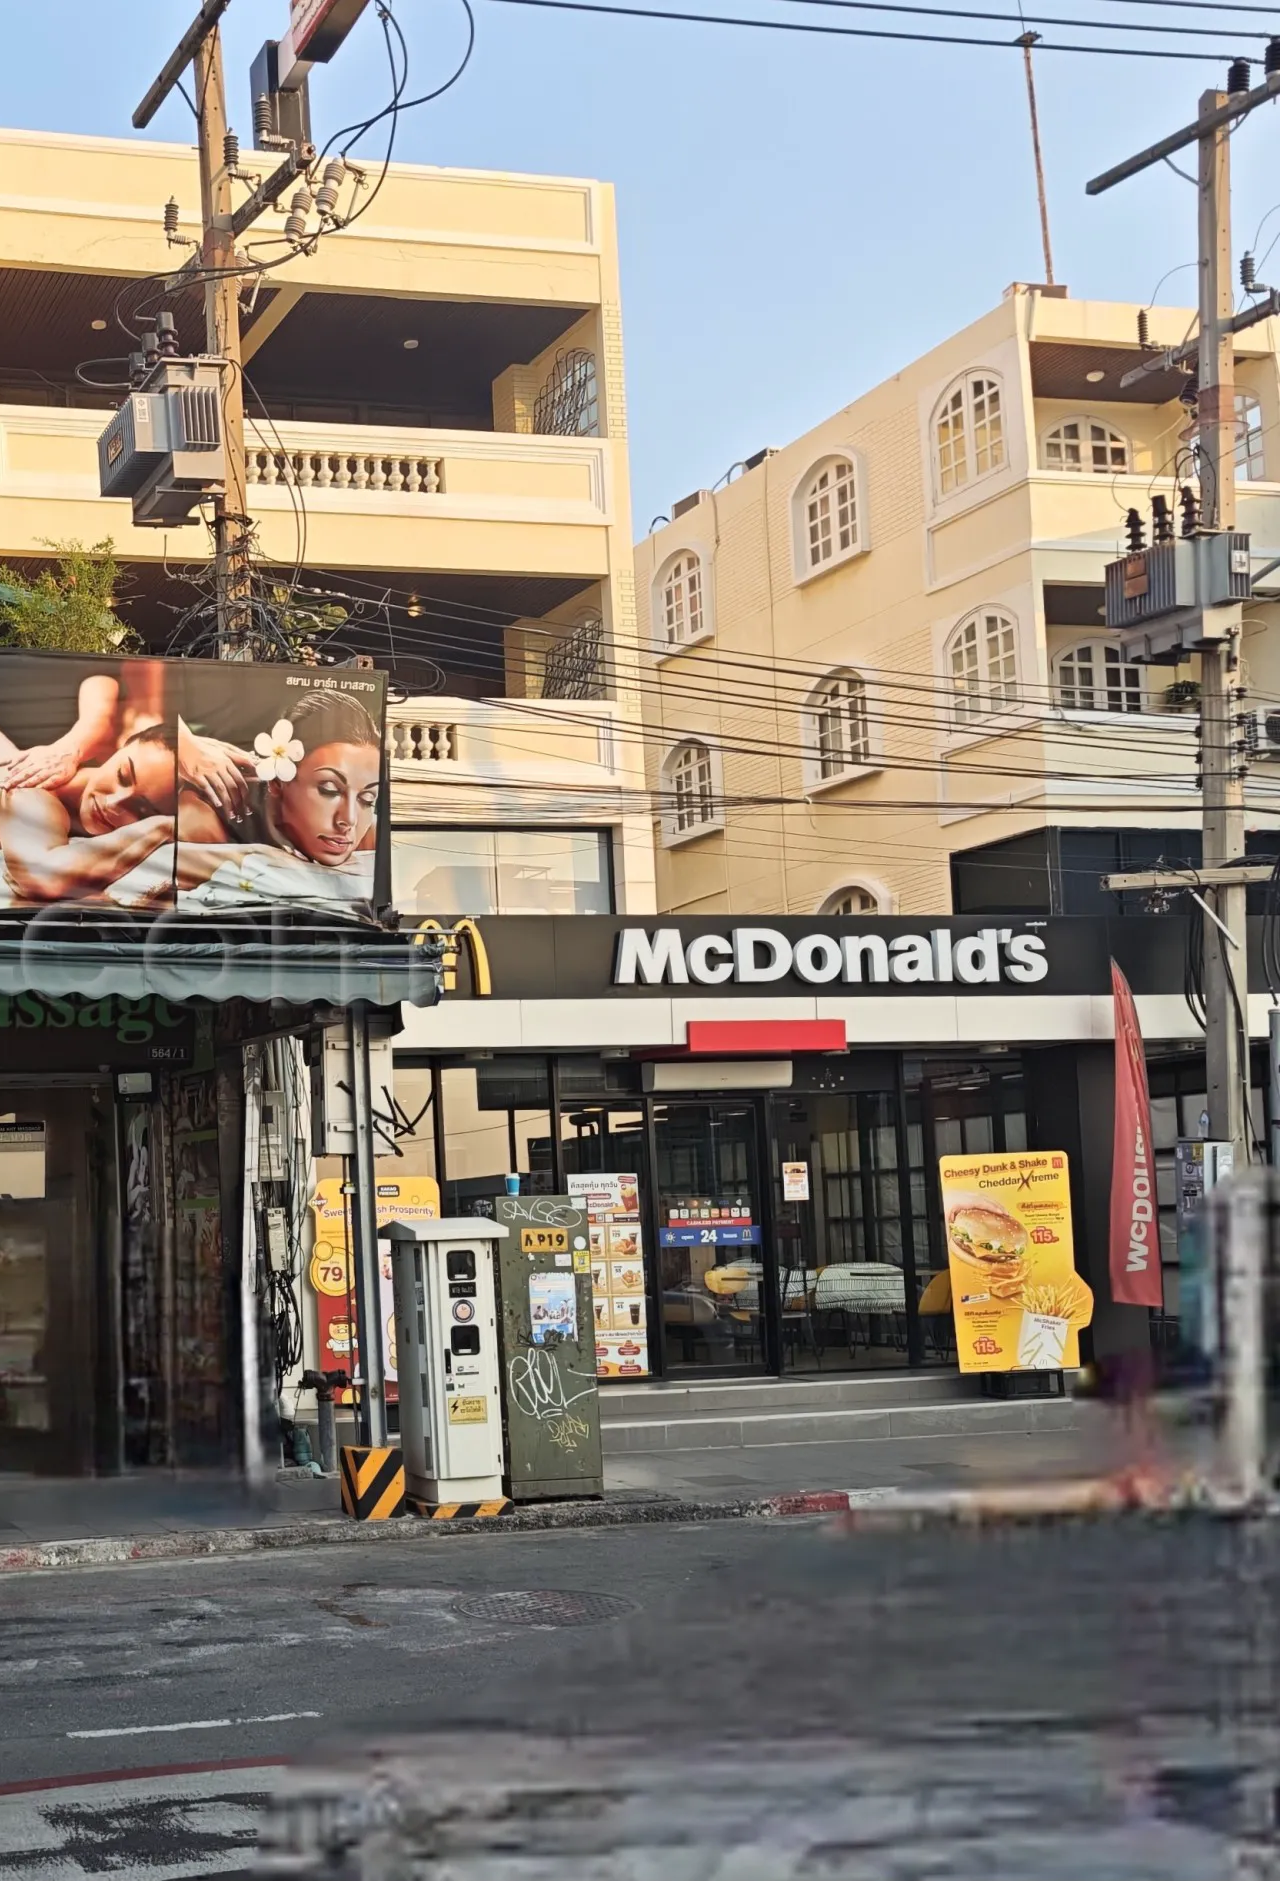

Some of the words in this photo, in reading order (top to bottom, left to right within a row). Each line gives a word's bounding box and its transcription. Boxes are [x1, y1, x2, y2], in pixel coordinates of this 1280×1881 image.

[286, 676, 311, 687] สยาม
[615, 928, 1050, 984] McDonald's
[943, 1167, 980, 1179] Cheesy
[982, 1163, 1008, 1174] Dunk
[1009, 1161, 1018, 1171] &
[1018, 1158, 1048, 1169] Shake
[389, 1204, 434, 1218] Prosperity
[700, 1230, 718, 1243] 24
[1032, 1231, 1052, 1243] 115
[320, 1266, 344, 1283] 79
[974, 1341, 995, 1353] 115
